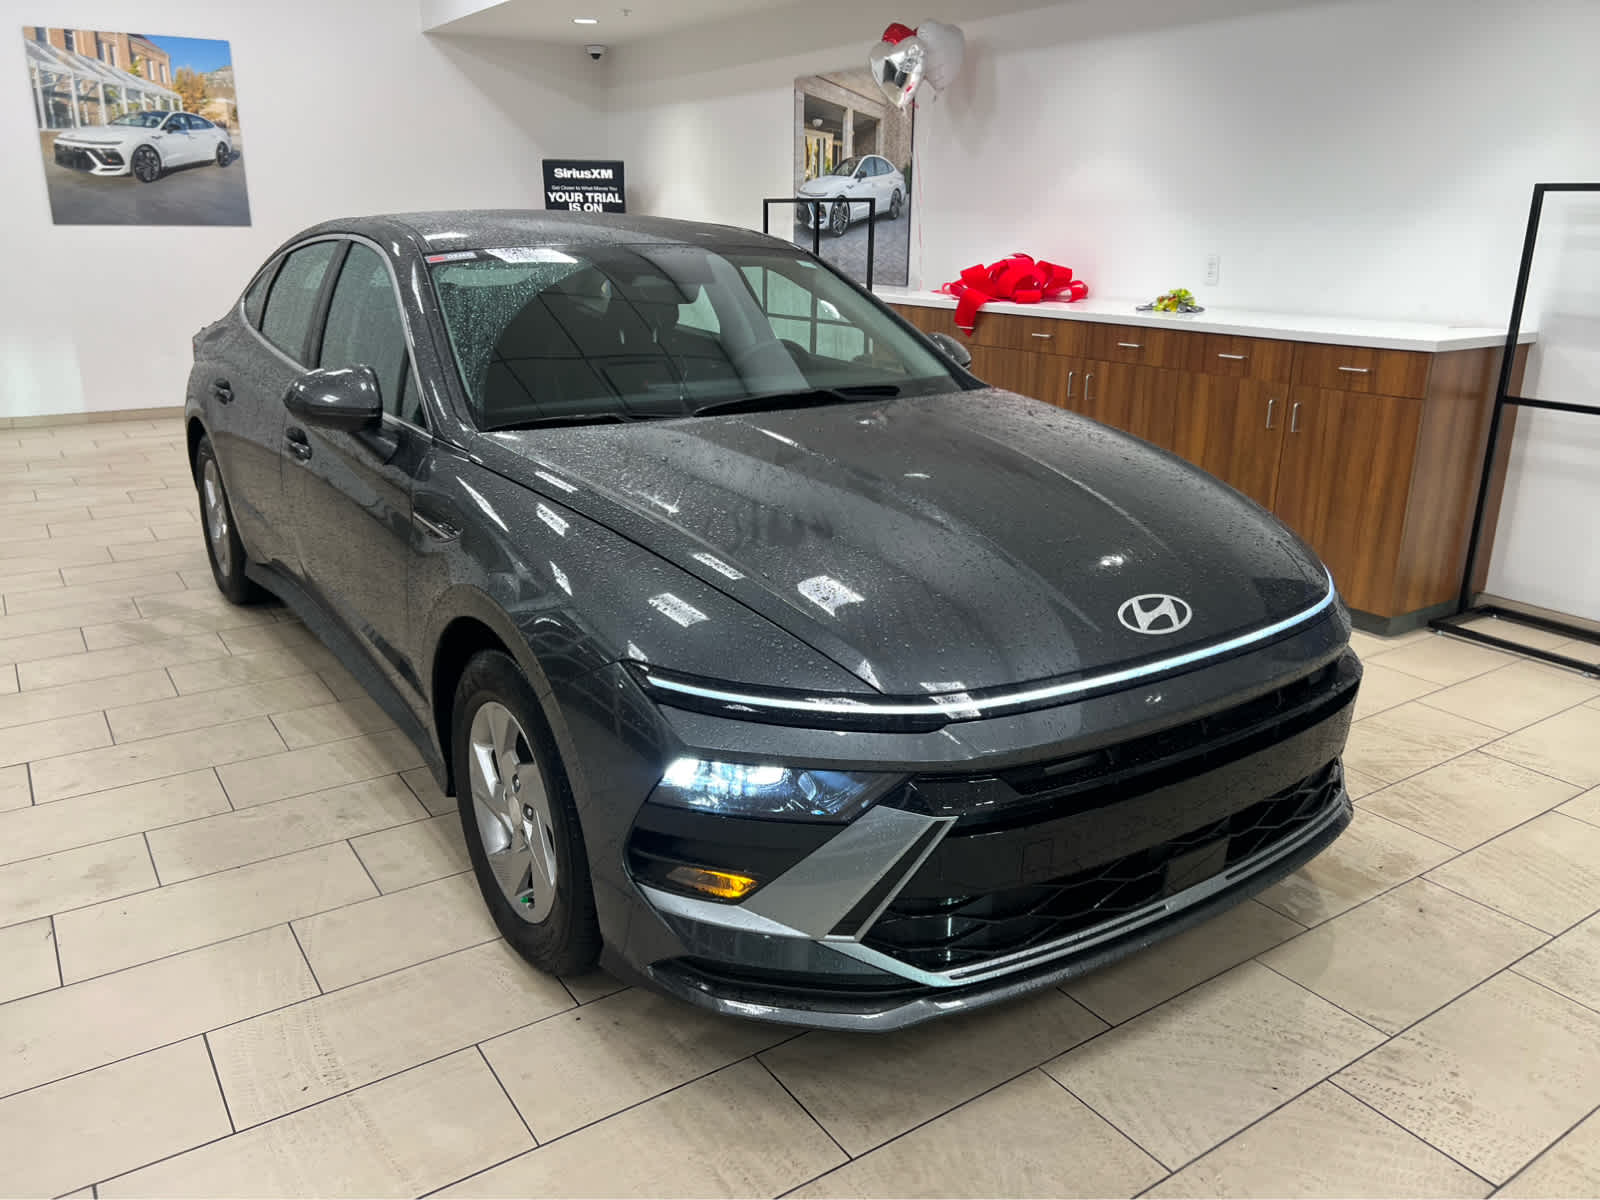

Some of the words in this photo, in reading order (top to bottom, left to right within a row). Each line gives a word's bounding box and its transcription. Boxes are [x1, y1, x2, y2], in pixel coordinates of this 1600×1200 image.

[553, 168, 613, 179] SiriusXM
[547, 191, 583, 203] YOUR
[585, 192, 623, 203] TRIAL
[568, 202, 581, 212] IS
[583, 203, 603, 213] ON
